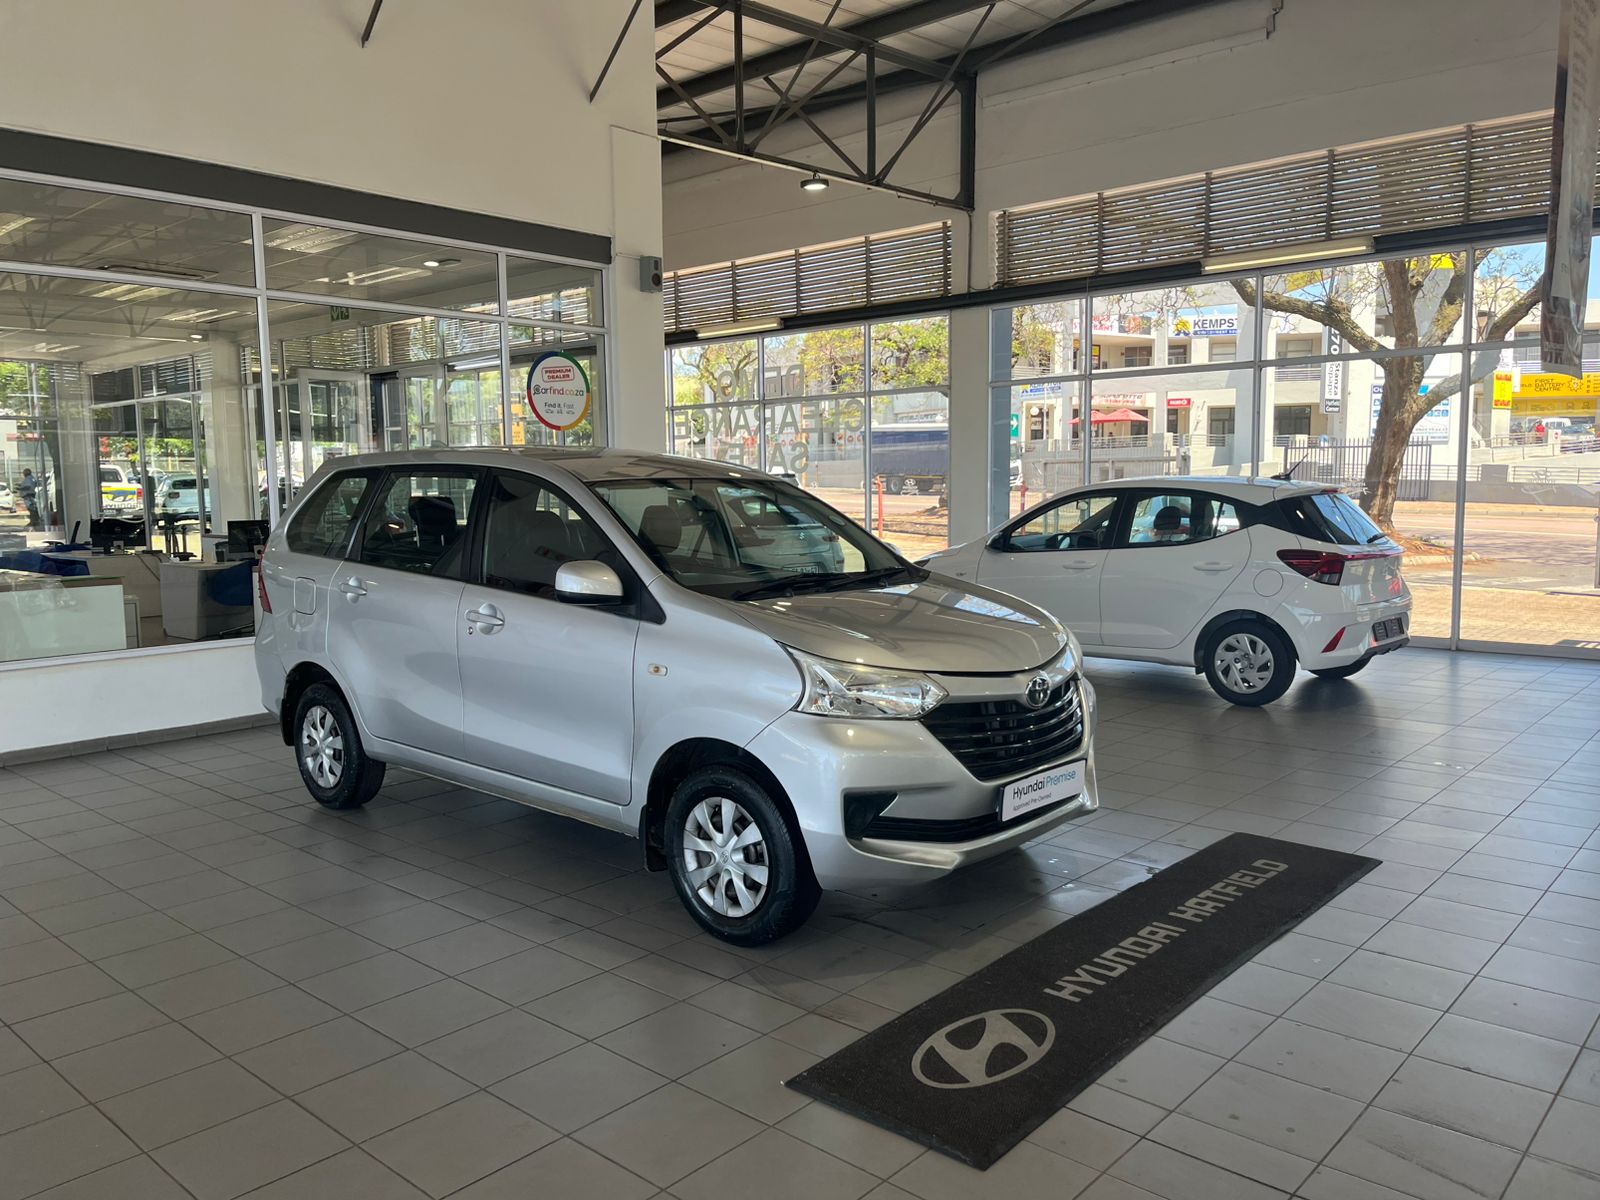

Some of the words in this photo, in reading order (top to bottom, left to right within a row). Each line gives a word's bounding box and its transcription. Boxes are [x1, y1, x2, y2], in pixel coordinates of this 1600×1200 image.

[1193, 318, 1238, 329] KEMPS
[1013, 777, 1046, 800] Hyundai
[1043, 922, 1187, 1003] HYUNDAI
[1168, 858, 1289, 922] HATFIELD
